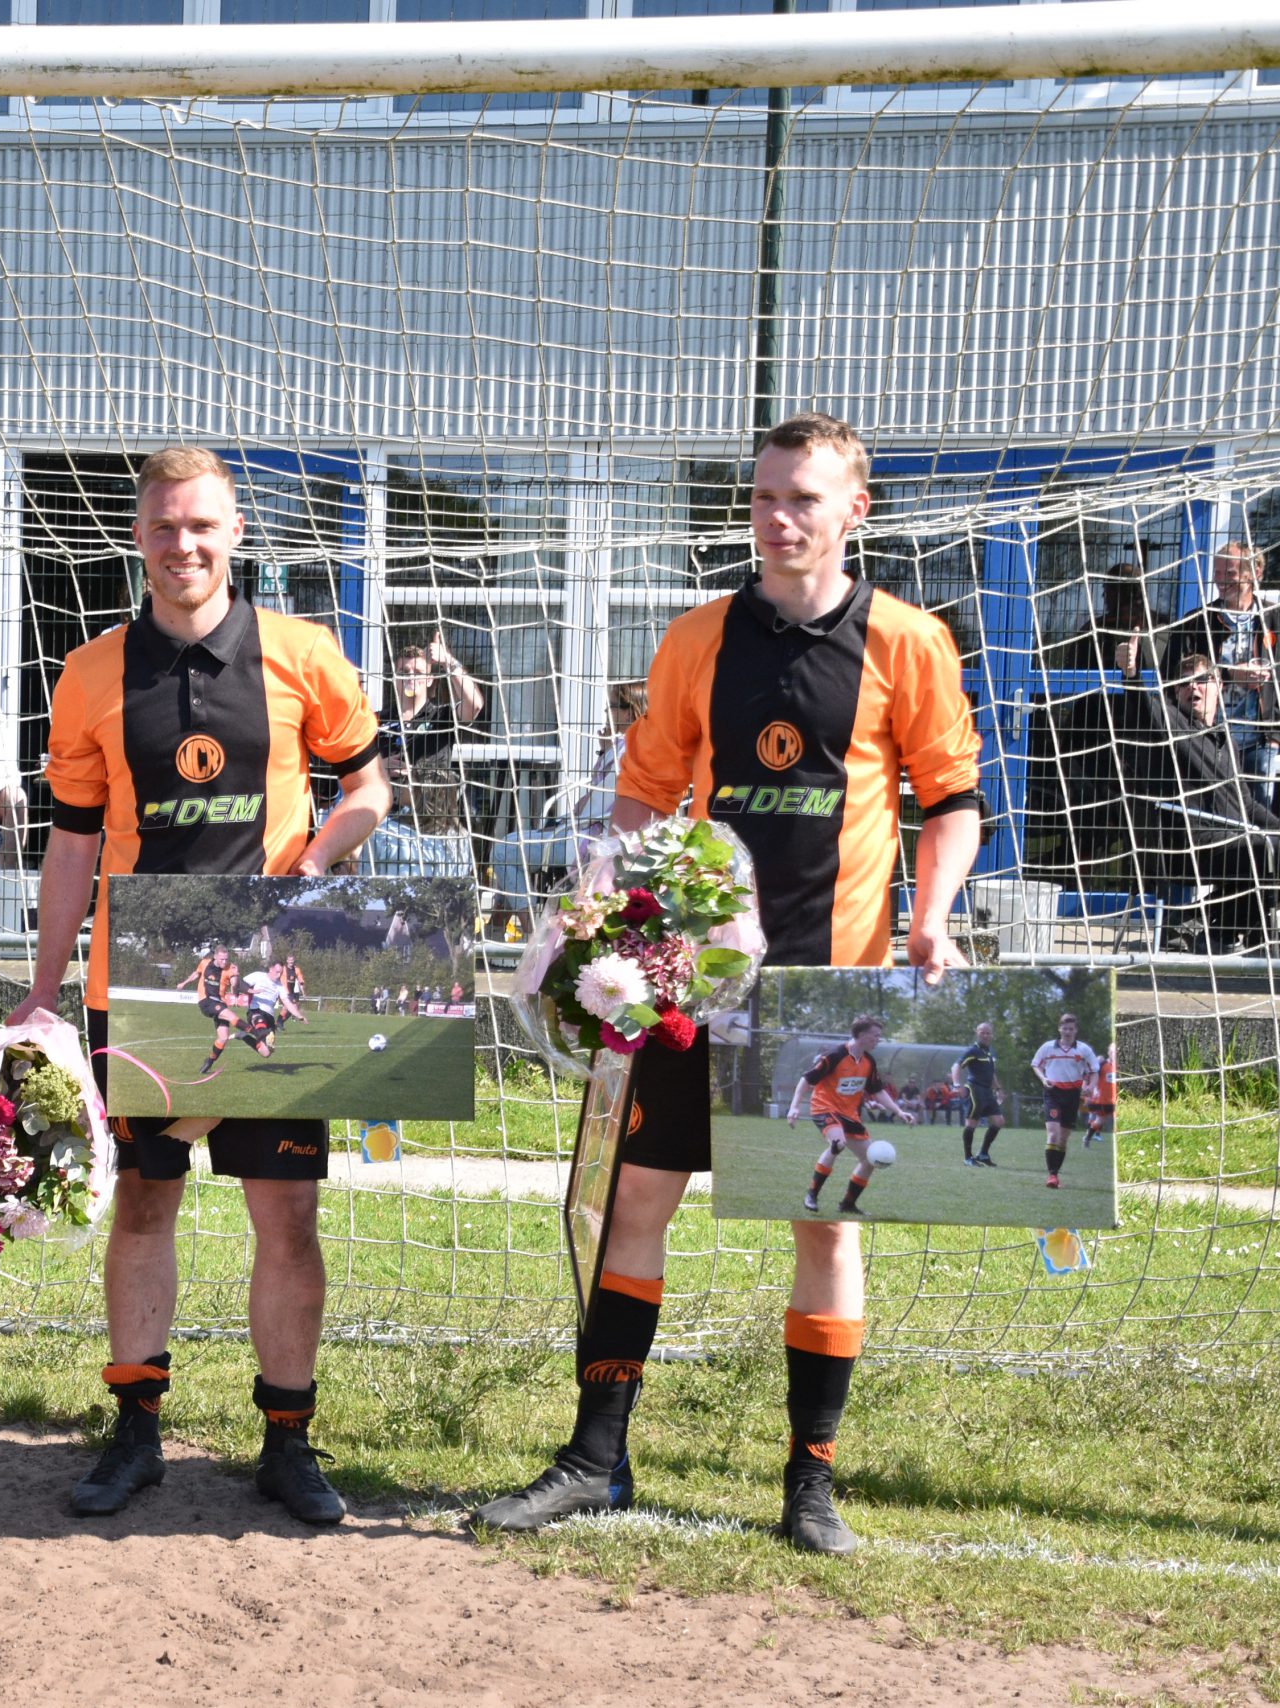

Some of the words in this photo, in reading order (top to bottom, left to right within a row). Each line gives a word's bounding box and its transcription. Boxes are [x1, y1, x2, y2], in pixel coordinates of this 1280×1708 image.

[179, 738, 221, 780] VCR
[173, 794, 264, 826] DEM
[747, 786, 844, 817] DEM
